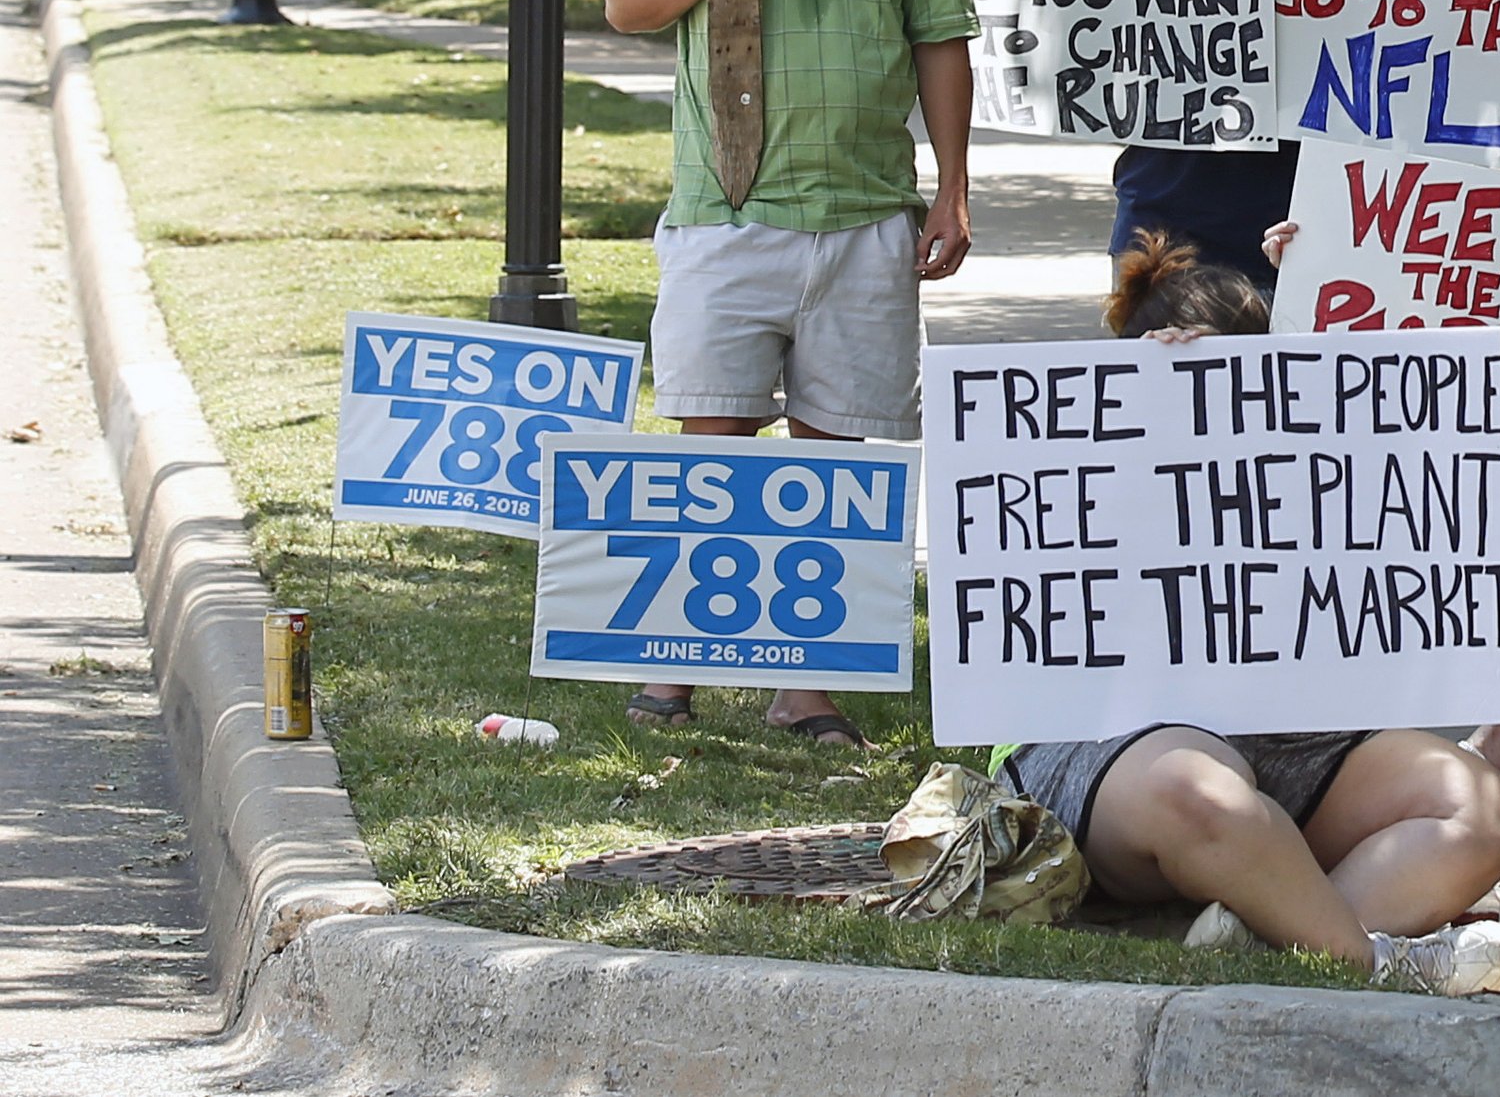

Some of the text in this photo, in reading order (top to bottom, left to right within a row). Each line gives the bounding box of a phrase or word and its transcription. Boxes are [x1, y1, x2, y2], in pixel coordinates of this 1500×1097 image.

[977, 13, 1269, 85] TO CHANGE
[971, 65, 1037, 127] HE
[366, 334, 621, 413] YES ON
[953, 364, 1146, 443] FREE
[1172, 352, 1323, 436] THE
[402, 488, 531, 516] JUNE 26, 2018
[566, 459, 891, 531] YES ON
[956, 465, 1119, 556] FREE
[1154, 453, 1299, 551] THE
[606, 535, 848, 639] 788
[956, 568, 1127, 668] FREE
[1140, 562, 1281, 666] THE
[639, 641, 806, 667] JUNE 26, 2018
